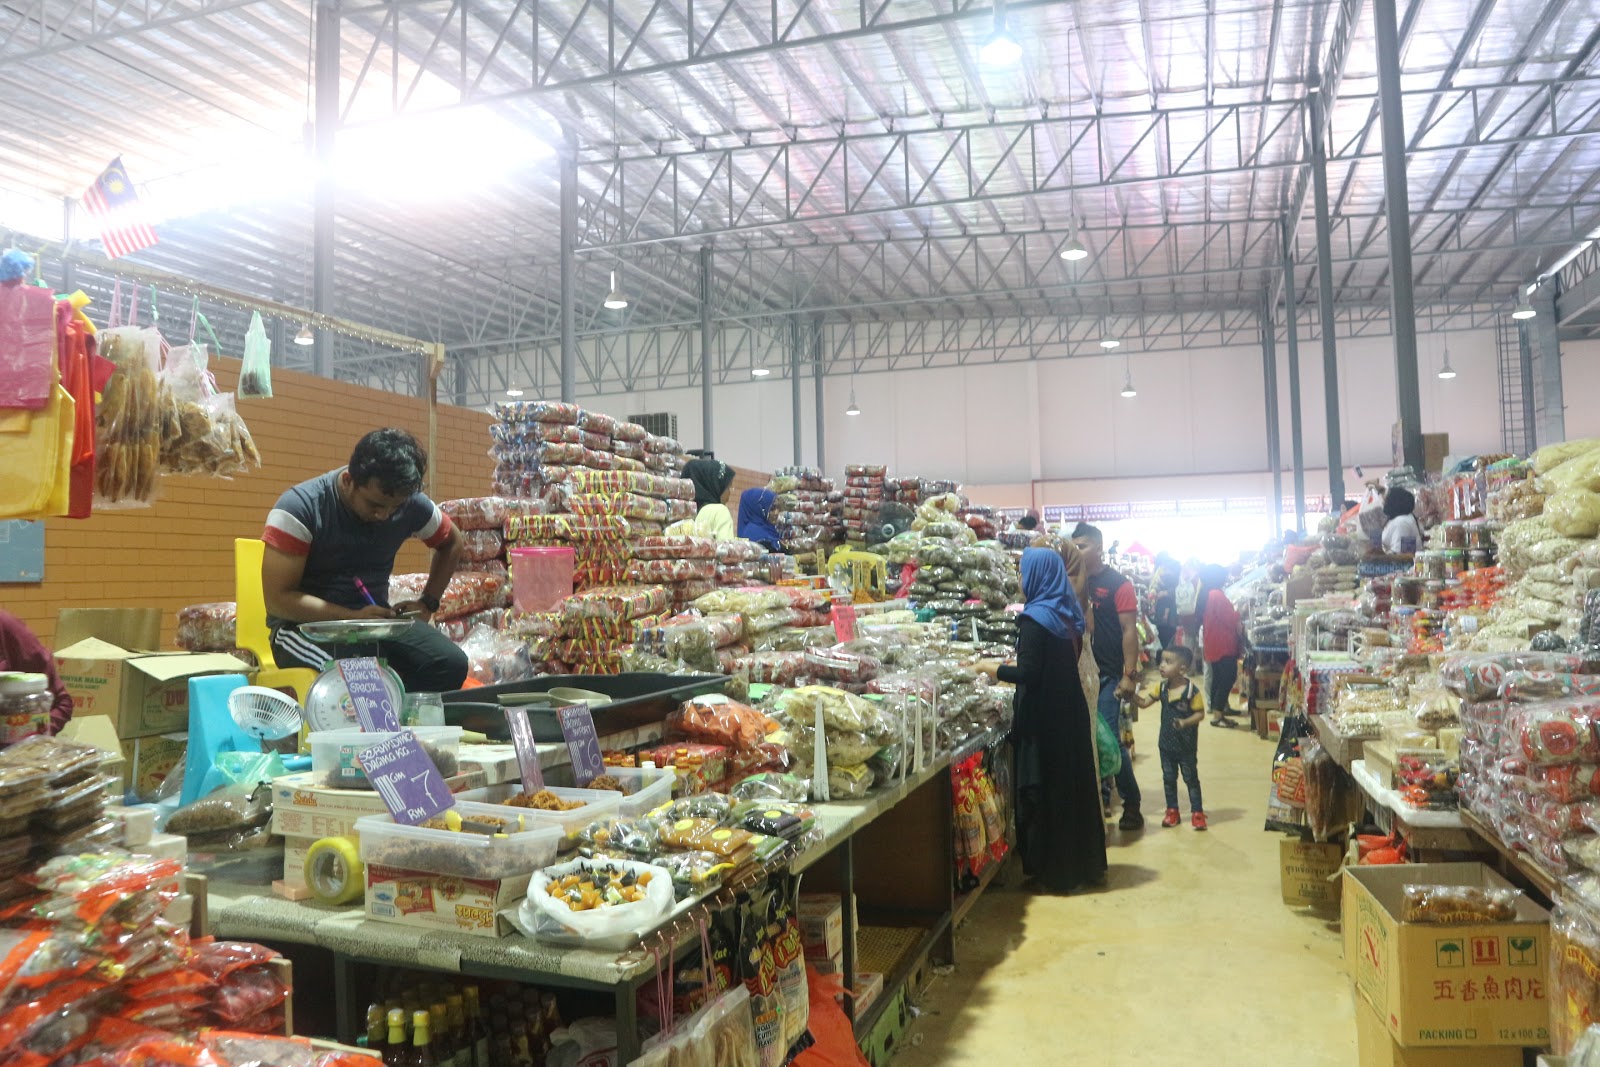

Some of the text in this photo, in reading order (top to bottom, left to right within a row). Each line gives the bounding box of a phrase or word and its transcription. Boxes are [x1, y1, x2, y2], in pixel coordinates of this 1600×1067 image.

[364, 752, 396, 772] DAGING
[588, 736, 600, 768] 6
[410, 770, 438, 808] 7
[407, 806, 426, 821] RM
[1433, 974, 1546, 1002] 五香魚肉片
[1419, 1028, 1462, 1040] PACKING
